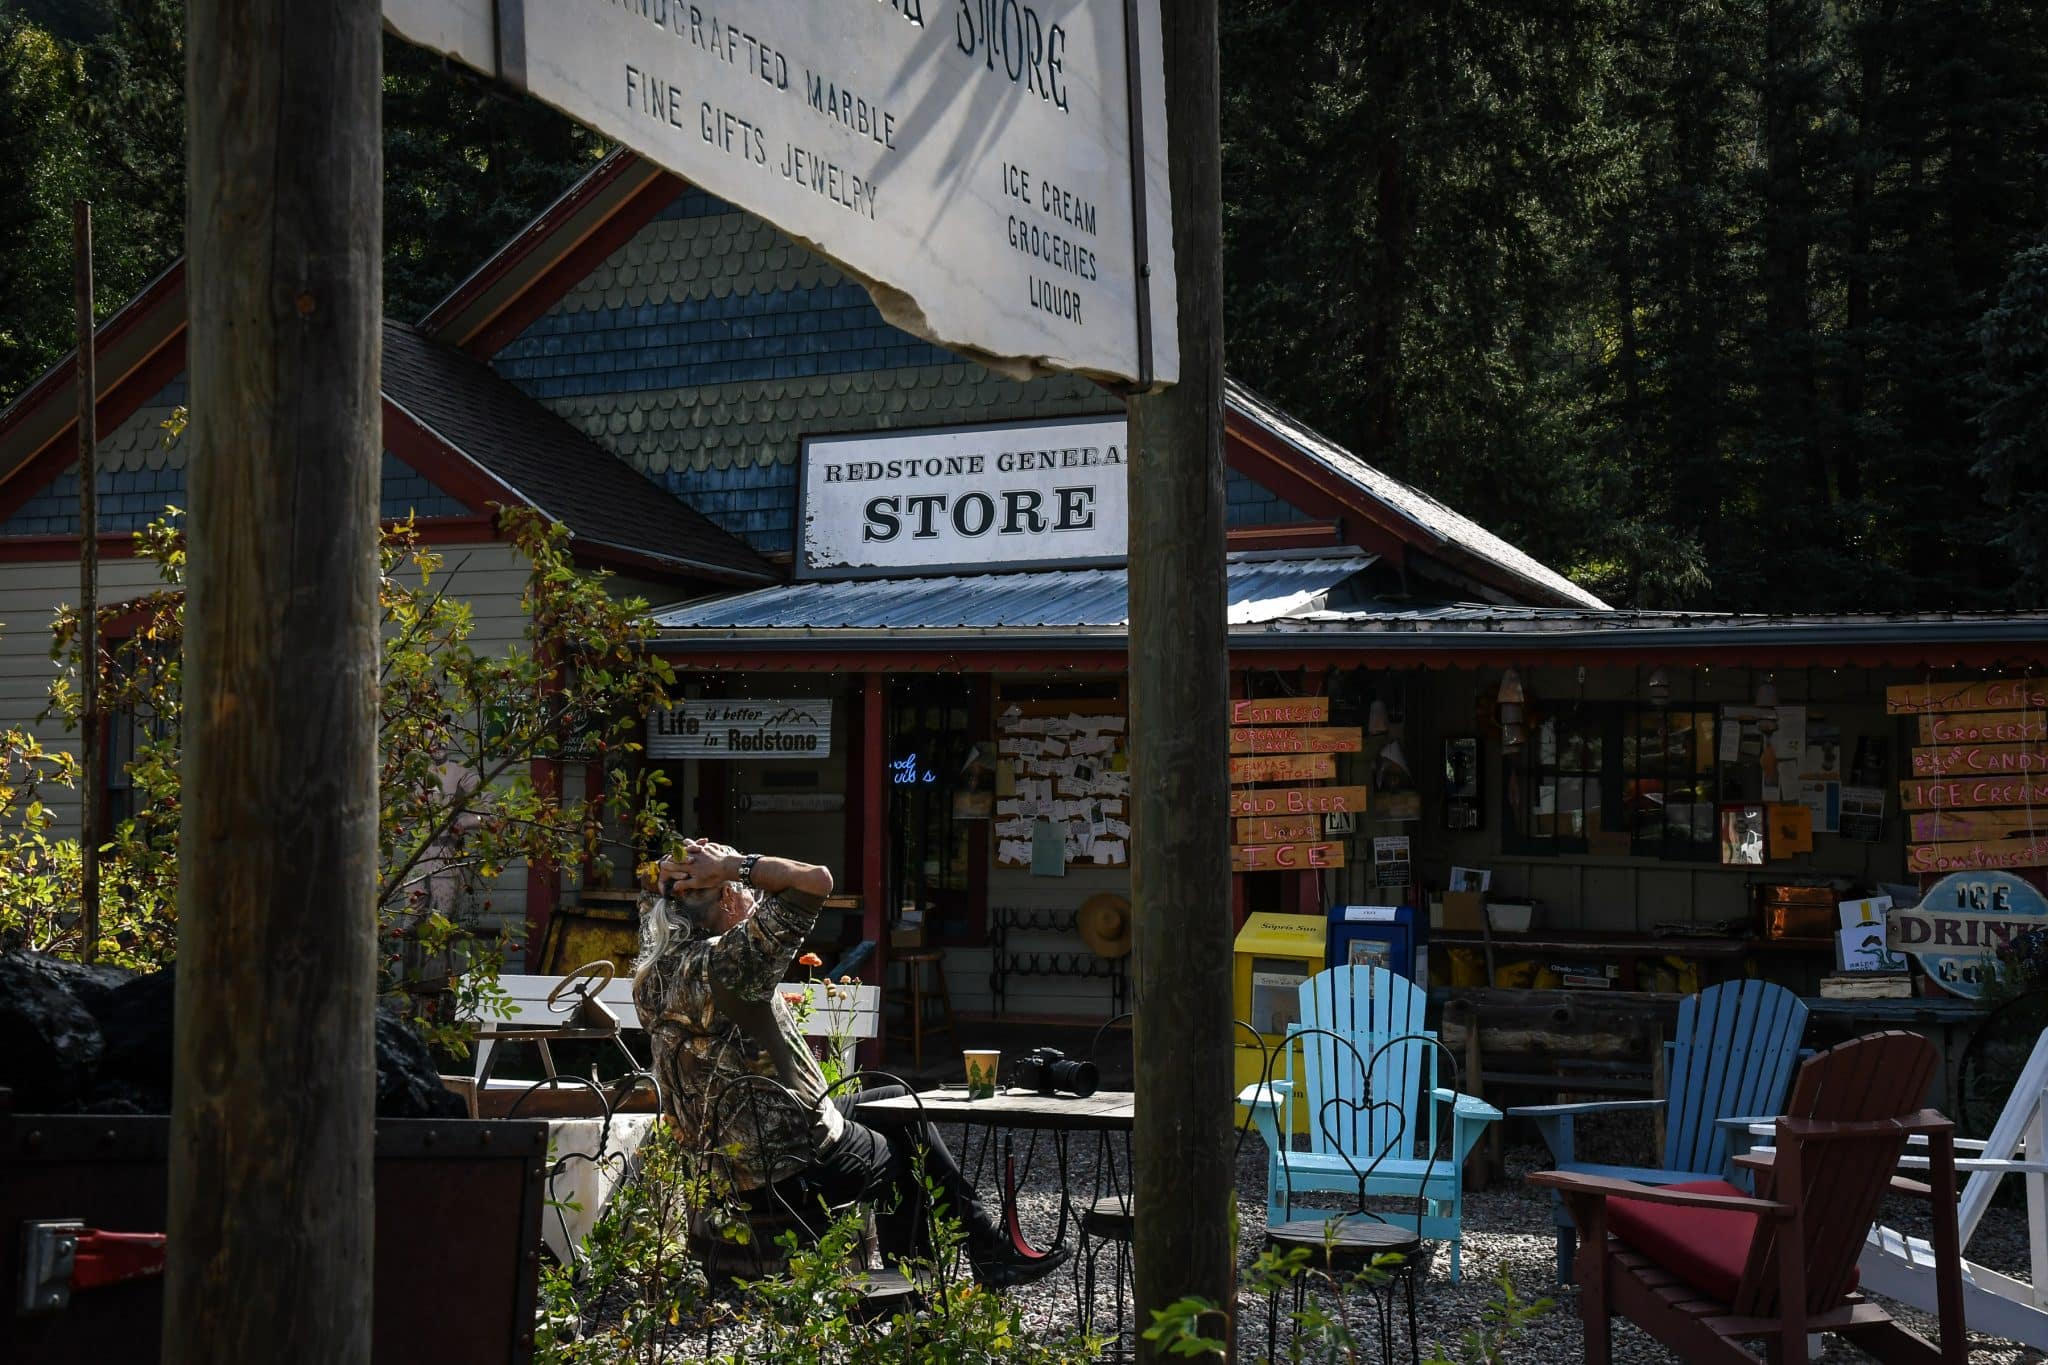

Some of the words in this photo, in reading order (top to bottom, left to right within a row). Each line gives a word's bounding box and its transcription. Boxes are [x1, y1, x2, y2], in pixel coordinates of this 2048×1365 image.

[957, 0, 1068, 114] STORE
[804, 69, 896, 151] MARBLE
[625, 64, 683, 129] FINE
[780, 143, 878, 221] JEWELRY
[1003, 162, 1031, 205] ICE
[1041, 181, 1097, 236] CREAM
[1008, 215, 1097, 282] GROCERIES
[1028, 275, 1082, 325] LIQUOR
[824, 454, 986, 483] REDSTONE
[996, 444, 1128, 473] GENERA
[863, 485, 1096, 543] STORE
[657, 710, 700, 735] Life
[705, 708, 717, 720] is
[723, 707, 763, 721] better
[1234, 728, 1297, 742] ORGANIC
[1932, 720, 2033, 741] GROCERY
[703, 733, 718, 746] in
[728, 728, 817, 751] Redstone
[1967, 748, 2048, 769] CANDY
[1286, 791, 1348, 813] BEER
[1916, 784, 1961, 806] ICE
[1240, 845, 1333, 867] ICE
[1956, 881, 2012, 911] ICE
[1295, 924, 1318, 933] Sun
